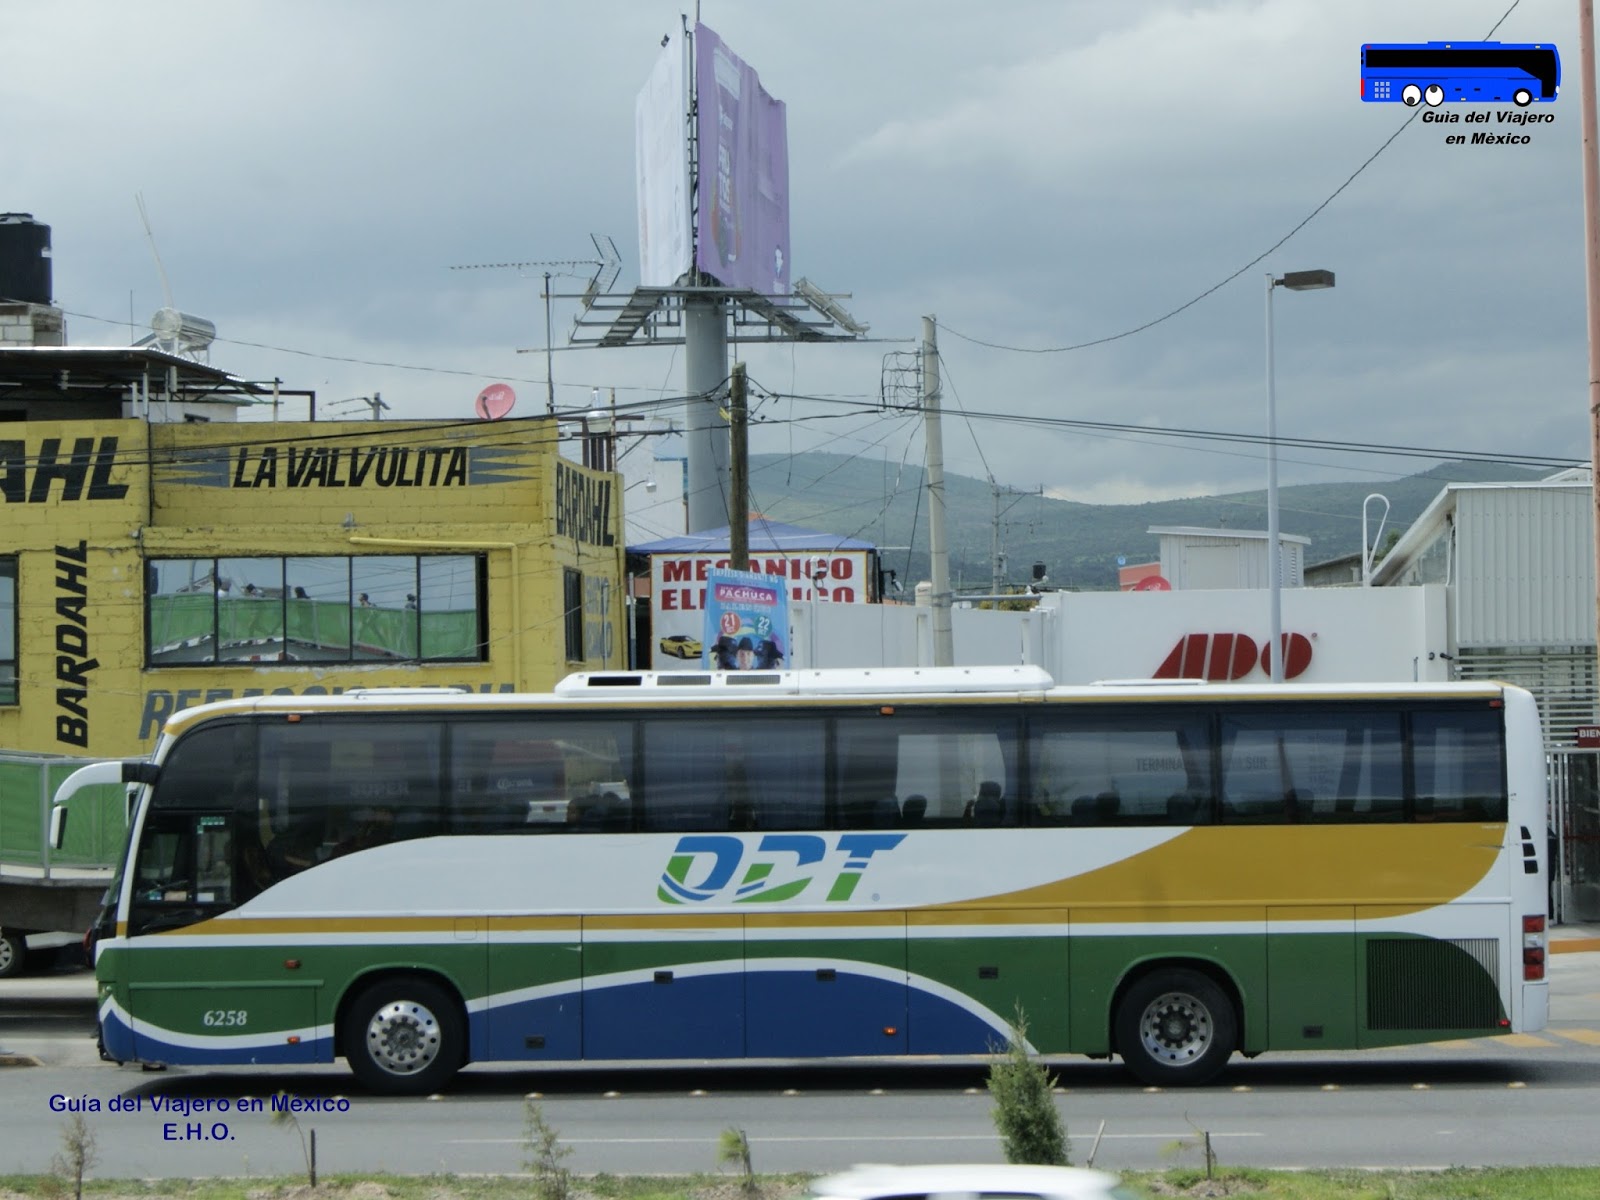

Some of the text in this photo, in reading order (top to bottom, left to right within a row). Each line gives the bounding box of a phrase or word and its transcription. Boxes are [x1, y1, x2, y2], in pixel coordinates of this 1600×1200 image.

[232, 446, 468, 488] LA VALVULITA
[556, 461, 615, 547] BARDAHL
[661, 587, 854, 611] ELICO
[719, 588, 773, 601] PACHUCA
[723, 613, 736, 628] 21
[757, 616, 770, 631] 22
[55, 539, 101, 749] BARDAHL
[1152, 632, 1313, 681] ADO
[1135, 757, 1188, 772] TERMINA
[656, 833, 909, 905] ODT
[203, 1010, 248, 1027] 6258
